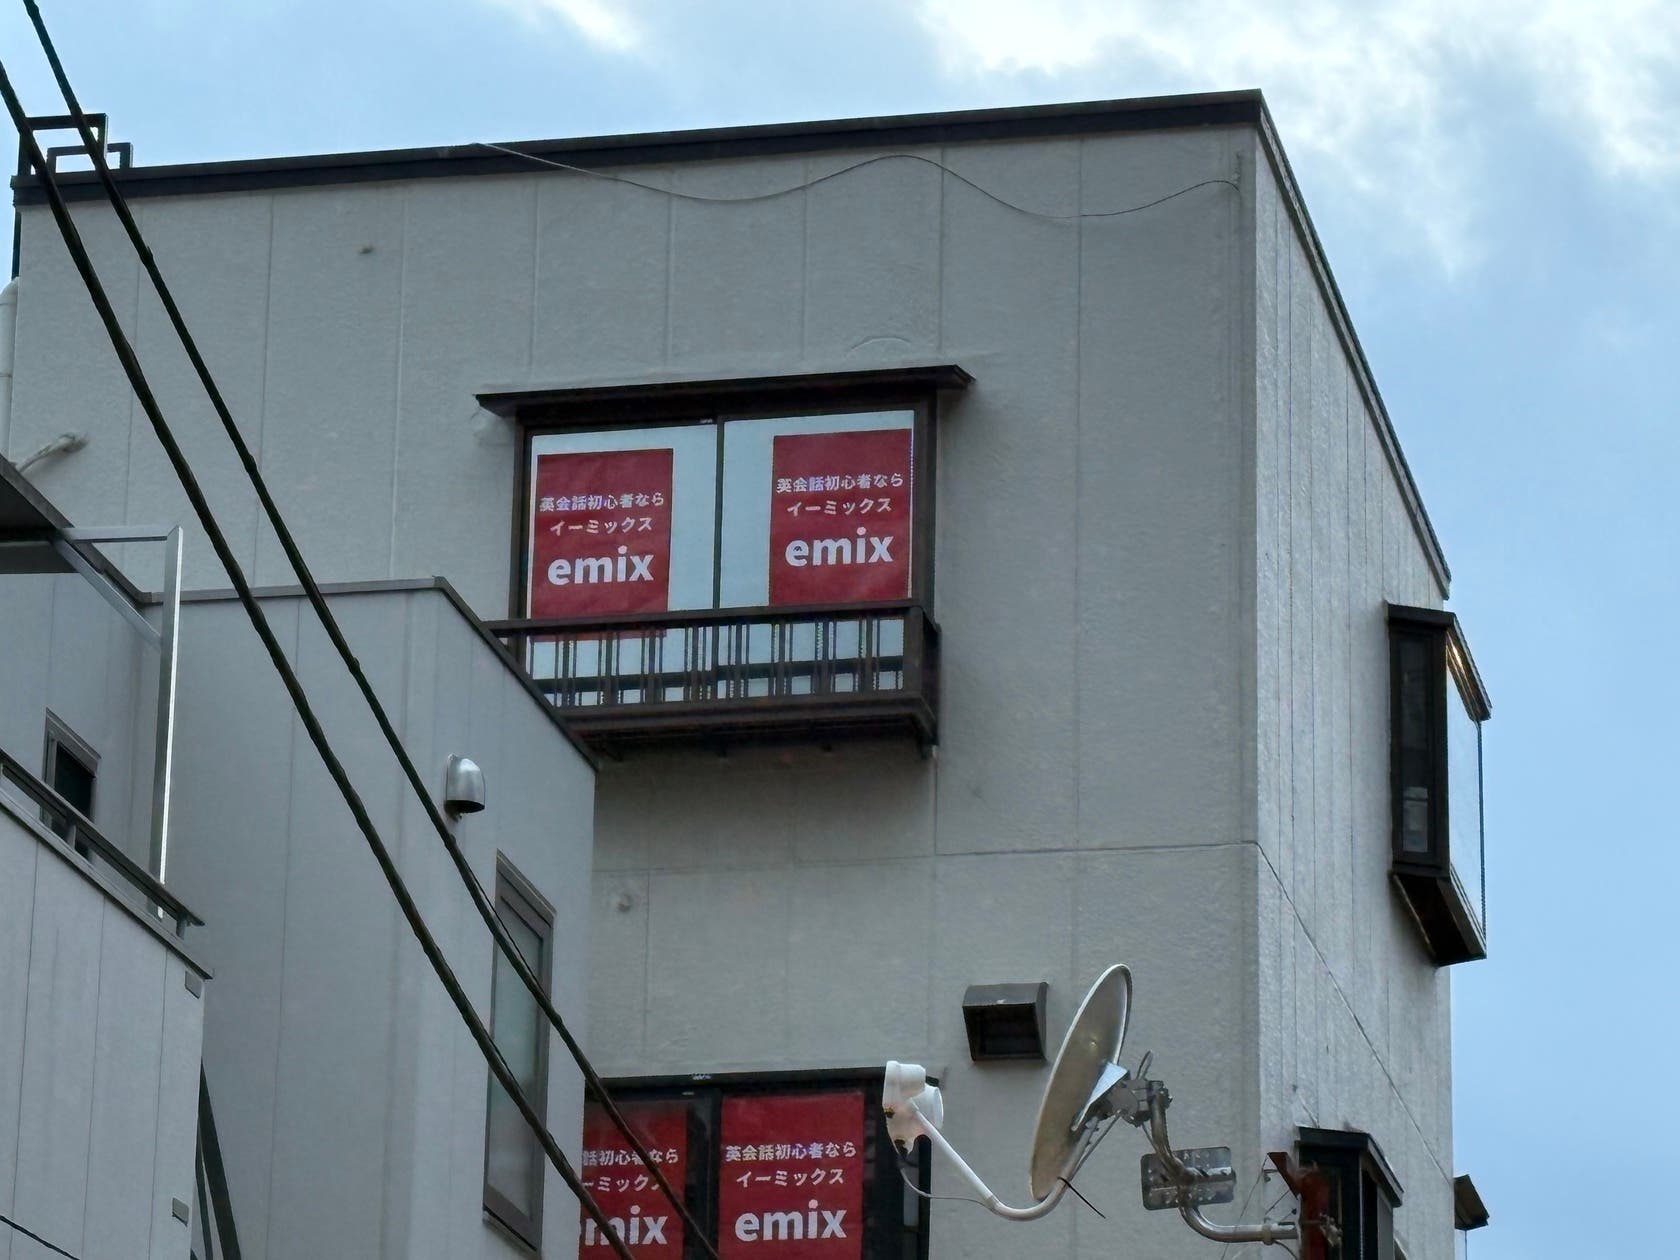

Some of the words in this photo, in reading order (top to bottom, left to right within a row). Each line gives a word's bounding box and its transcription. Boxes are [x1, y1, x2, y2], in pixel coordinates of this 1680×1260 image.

[777, 473, 903, 492] 英会話初心者なら
[540, 493, 664, 512] 英会話初心者なら
[787, 498, 892, 517] イーミックス
[550, 517, 652, 536] イーミックス
[785, 527, 894, 567] emix
[548, 545, 654, 586] emix
[725, 1141, 857, 1162] 英会話初心者なら
[582, 1174, 660, 1192] ーミック
[736, 1168, 844, 1188] イーミックス
[735, 1199, 847, 1242] emix
